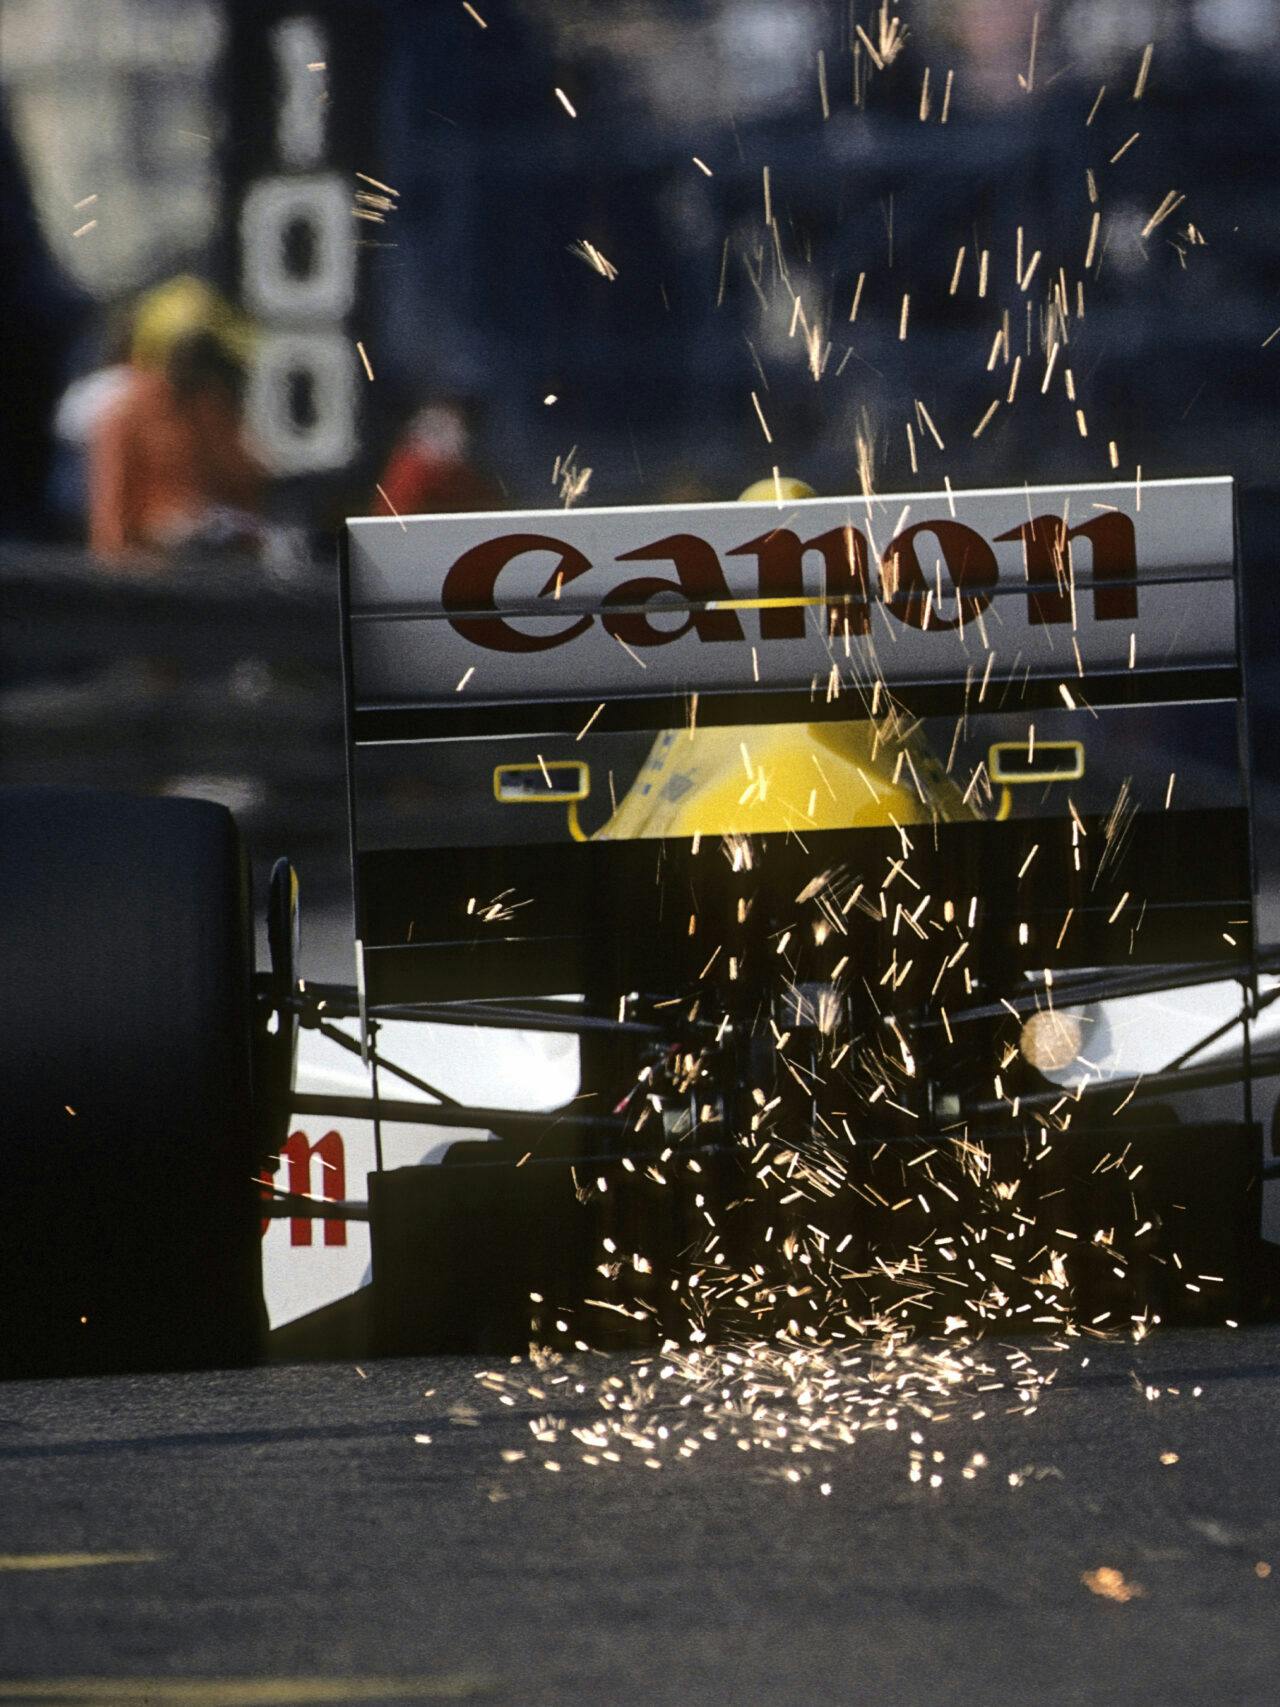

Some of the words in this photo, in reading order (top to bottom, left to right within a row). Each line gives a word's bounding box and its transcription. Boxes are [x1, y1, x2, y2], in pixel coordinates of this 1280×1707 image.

[241, 14, 361, 477] 100
[441, 511, 1140, 654] Canon
[260, 1129, 347, 1247] n
